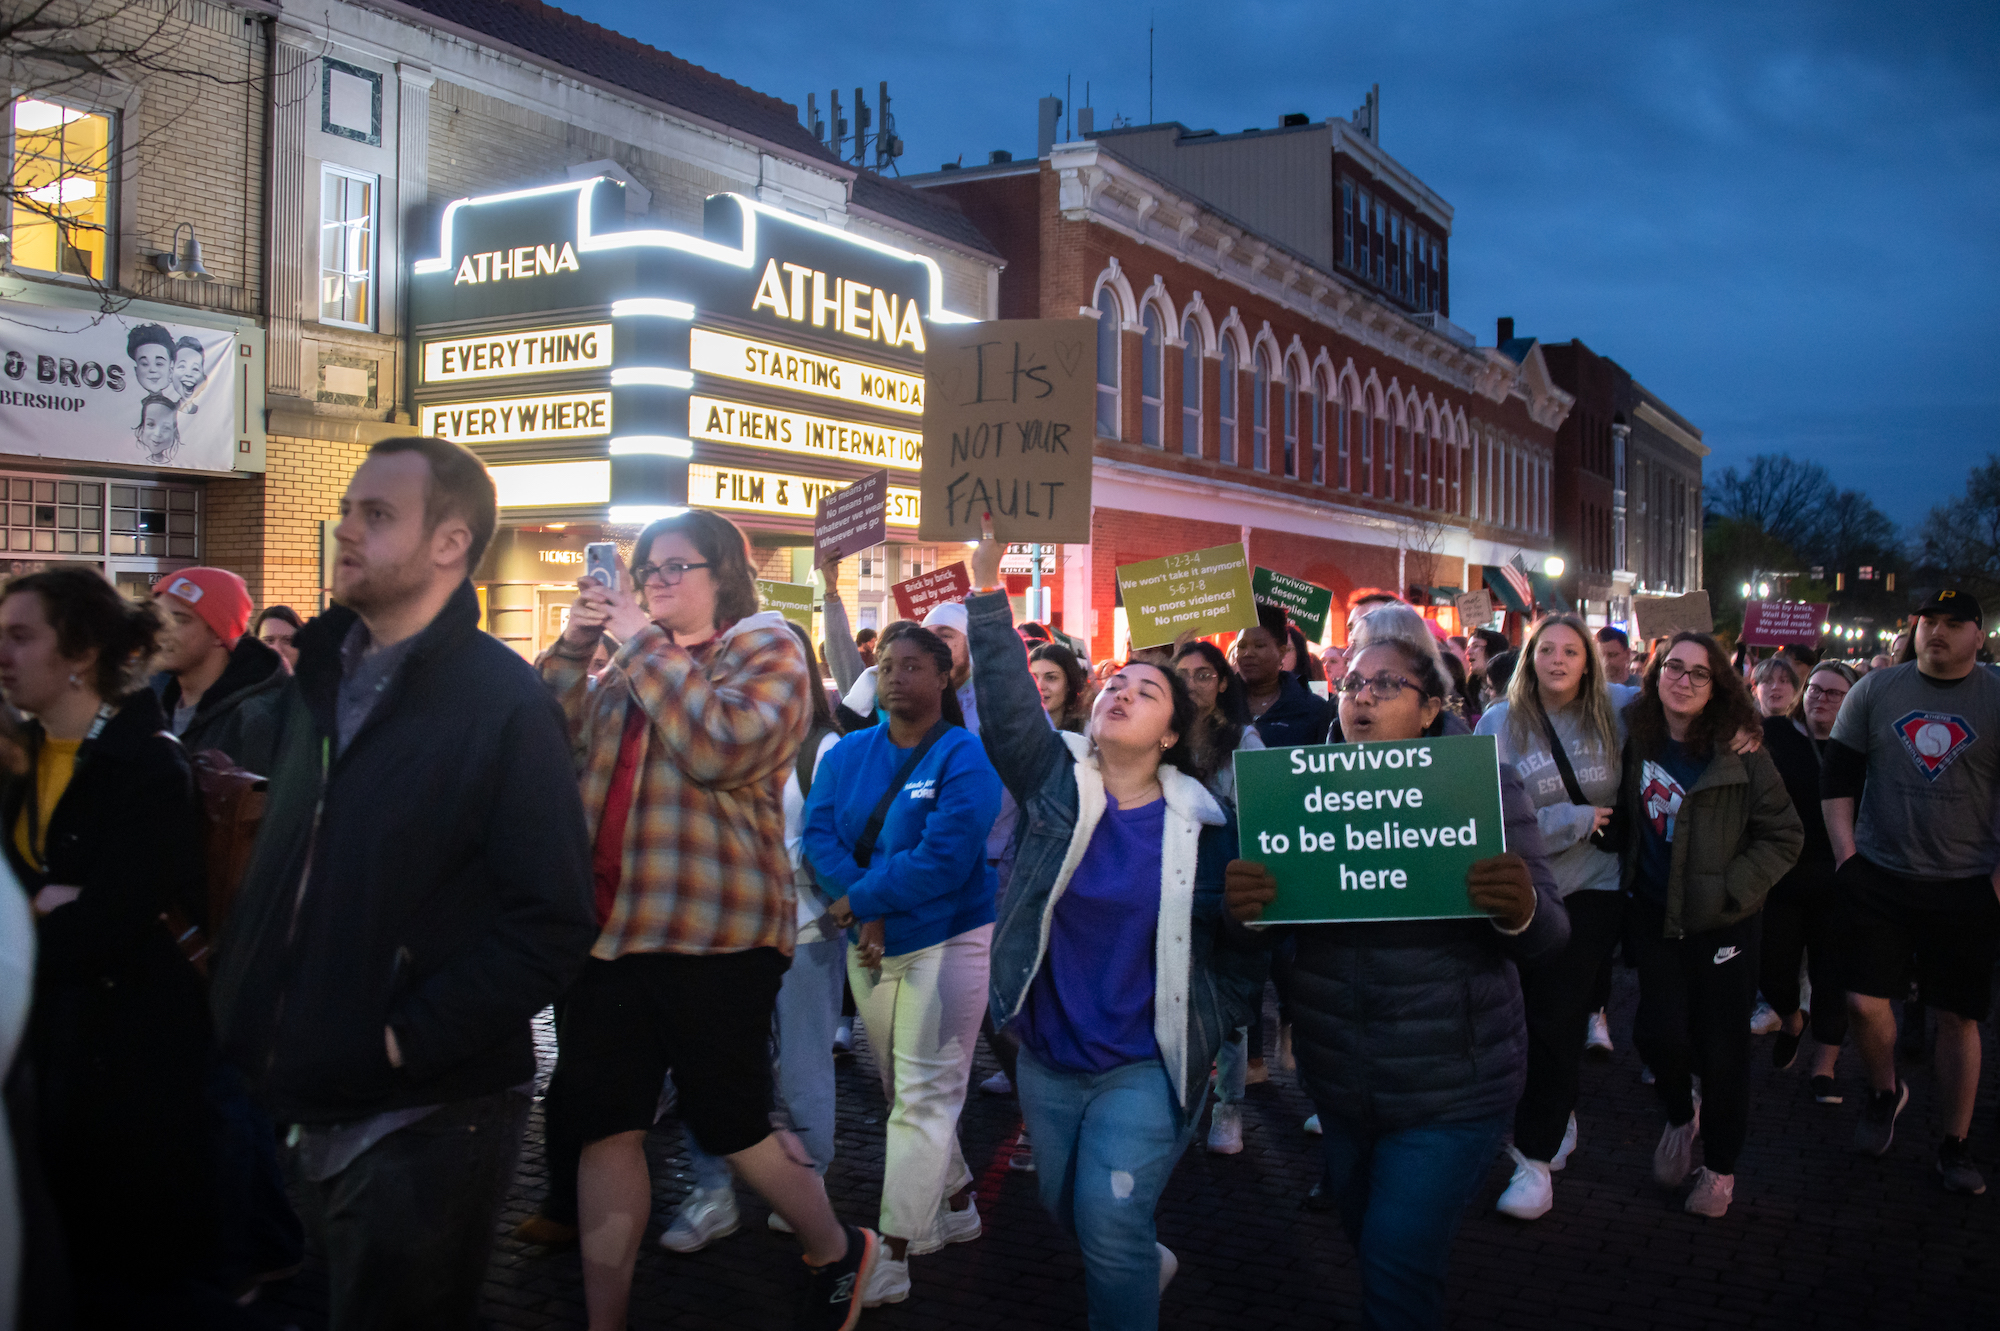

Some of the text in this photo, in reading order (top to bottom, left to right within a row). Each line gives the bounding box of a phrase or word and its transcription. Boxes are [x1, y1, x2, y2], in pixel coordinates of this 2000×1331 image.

[454, 241, 580, 286] ATHENA
[752, 257, 926, 352] ATHENA
[441, 331, 598, 374] EVERYTHING
[4, 350, 126, 393] & BROS
[745, 346, 923, 406] STARTING MONDA
[0, 390, 85, 412] BERSHOP
[434, 399, 606, 438] EVERYWHERE
[705, 405, 792, 444] ATHENS
[950, 419, 1071, 468] NOT YOUR
[716, 471, 764, 504] FILM
[776, 479, 788, 506] &
[825, 477, 876, 507] Yes means yes
[947, 472, 1064, 527] FAULT
[816, 501, 884, 538] Whatever we wear
[826, 492, 874, 520] No means no
[820, 517, 879, 549] Wherever we go
[539, 550, 584, 564] TICKETS
[1165, 552, 1201, 569] 1-2-3-4
[904, 580, 924, 593] Brick
[923, 577, 934, 587] by
[1121, 557, 1246, 590] We won't take it anymore!
[1270, 571, 1315, 594] Survivors
[909, 591, 928, 604] Wall
[927, 589, 938, 599] by
[1141, 588, 1236, 615] No more violence!
[1169, 579, 1206, 597] 5-6-7-8
[1254, 592, 1265, 603] to
[1271, 586, 1308, 605] deserve
[1938, 590, 1956, 601] P
[771, 599, 812, 612] anymore!
[912, 607, 926, 616] We
[1155, 603, 1230, 626] No more rape!
[1762, 603, 1815, 612] Brick by brick,
[1924, 714, 1952, 722] ATHENS
[1290, 744, 1433, 775] Survivors
[1304, 786, 1423, 813] deserve
[1258, 818, 1478, 854] to be believed
[1339, 864, 1408, 891] here
